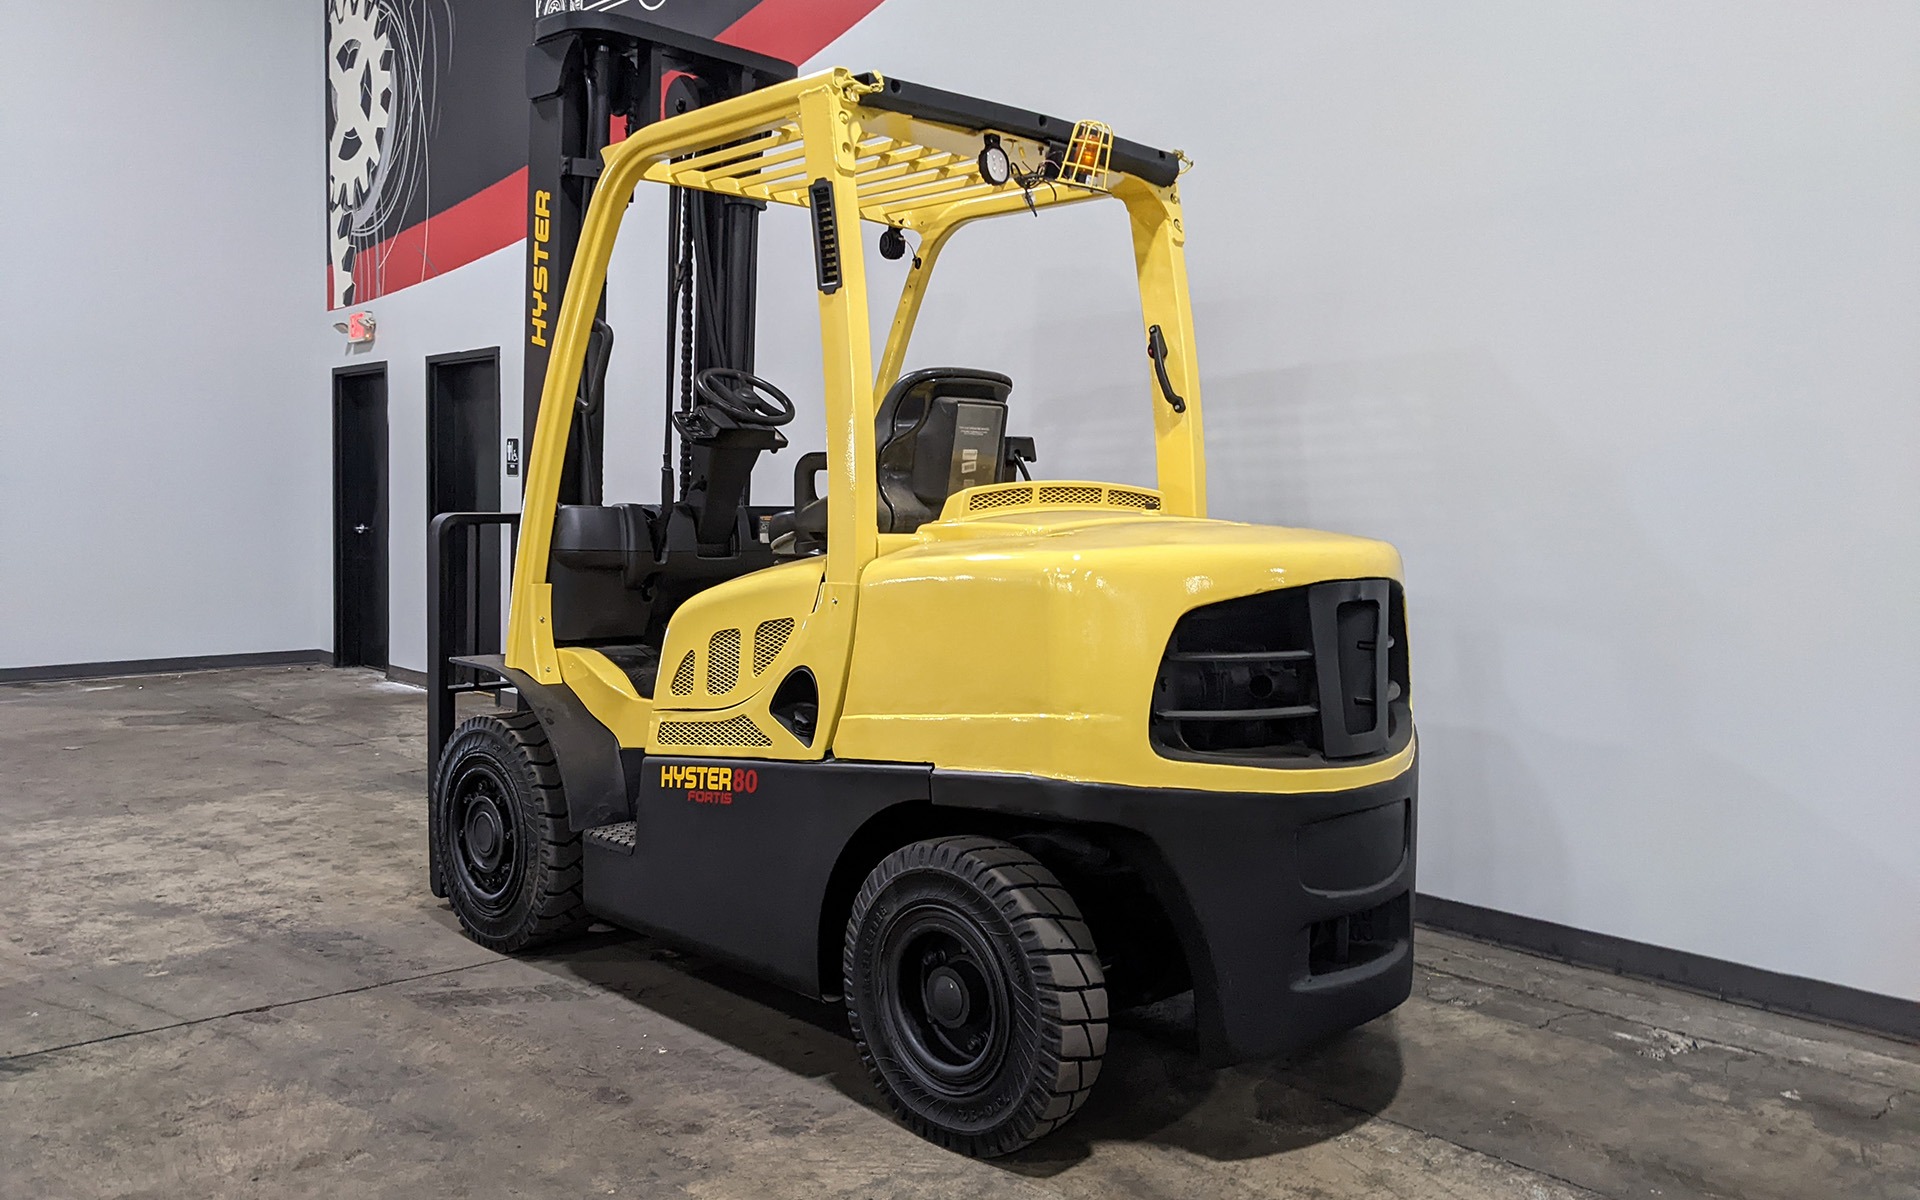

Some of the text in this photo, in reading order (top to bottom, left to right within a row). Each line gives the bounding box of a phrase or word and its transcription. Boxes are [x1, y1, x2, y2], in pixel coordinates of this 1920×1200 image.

[531, 189, 551, 348] HYSTER
[660, 765, 759, 794] HYSTER 80
[687, 790, 733, 804] FORTIS
